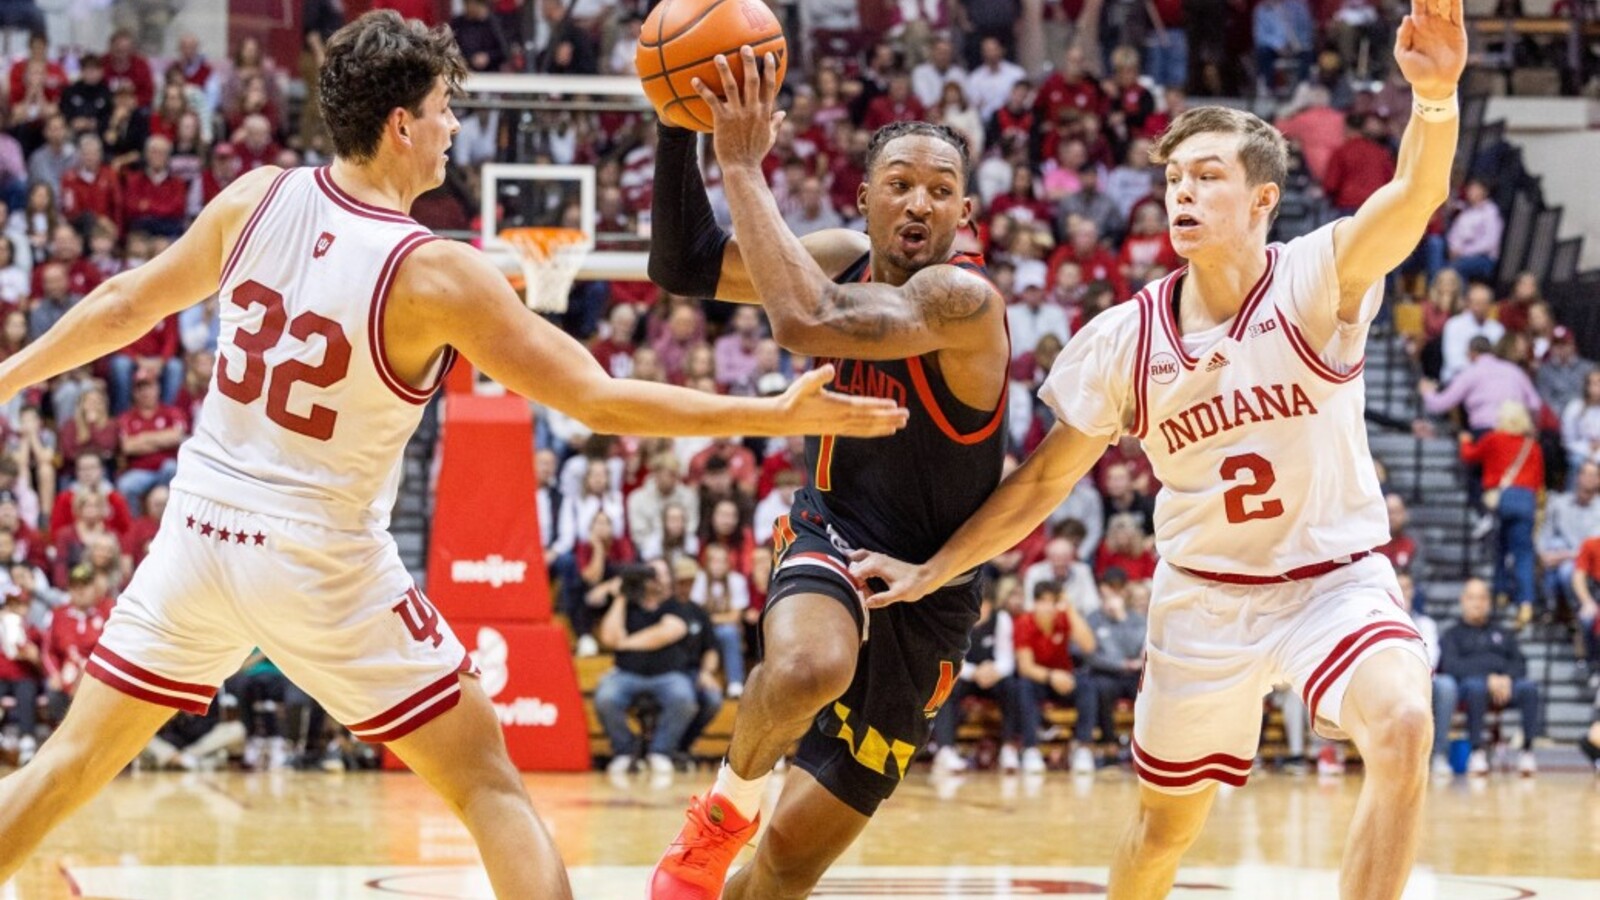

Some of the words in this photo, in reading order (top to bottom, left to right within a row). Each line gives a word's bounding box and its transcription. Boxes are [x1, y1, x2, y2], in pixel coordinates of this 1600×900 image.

[216, 279, 353, 441] 32
[816, 357, 907, 407] LAND
[1151, 363, 1176, 376] RMK
[1159, 383, 1318, 454] INDIANA
[1219, 452, 1285, 524] 2
[452, 554, 528, 588] meijer
